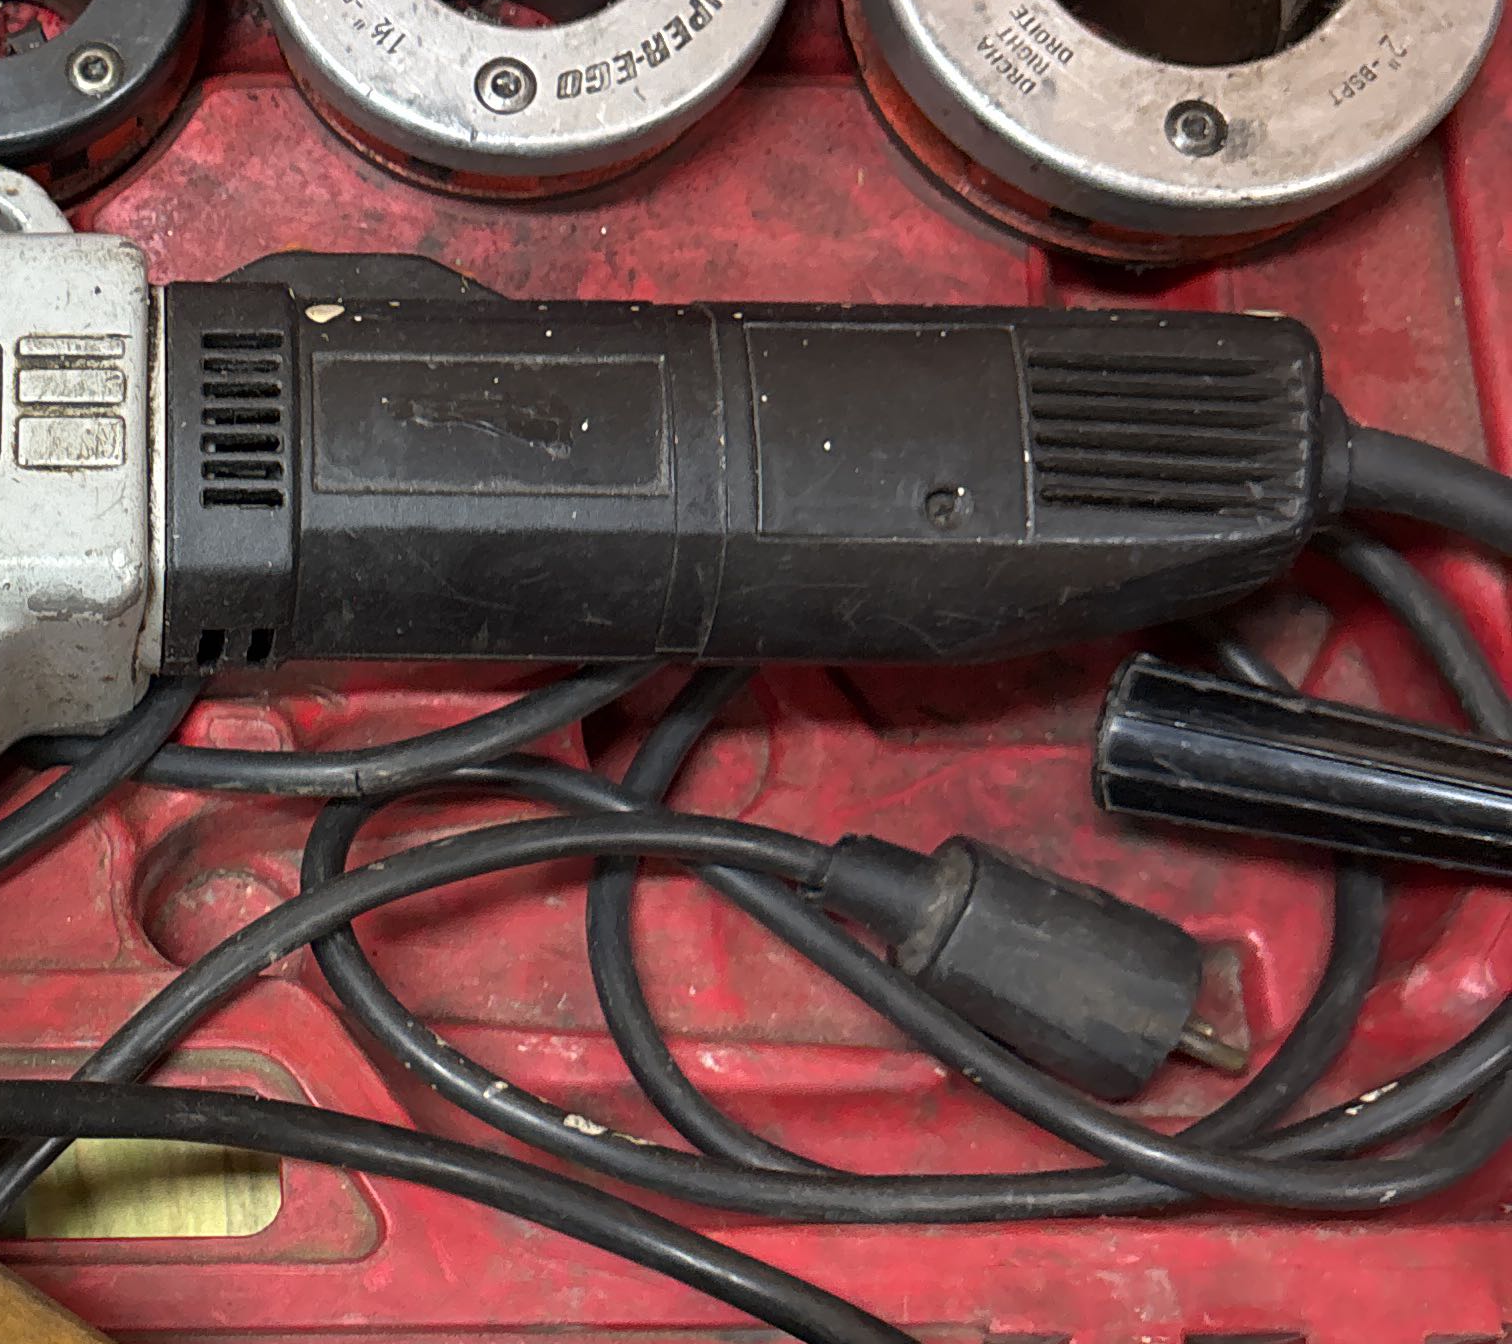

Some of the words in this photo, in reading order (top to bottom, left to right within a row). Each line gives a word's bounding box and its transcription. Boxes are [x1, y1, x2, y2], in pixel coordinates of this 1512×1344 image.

[995, 27, 1050, 76] RIGHT
[1008, 3, 1074, 64] DROITE
[976, 35, 1037, 94] DRCHA
